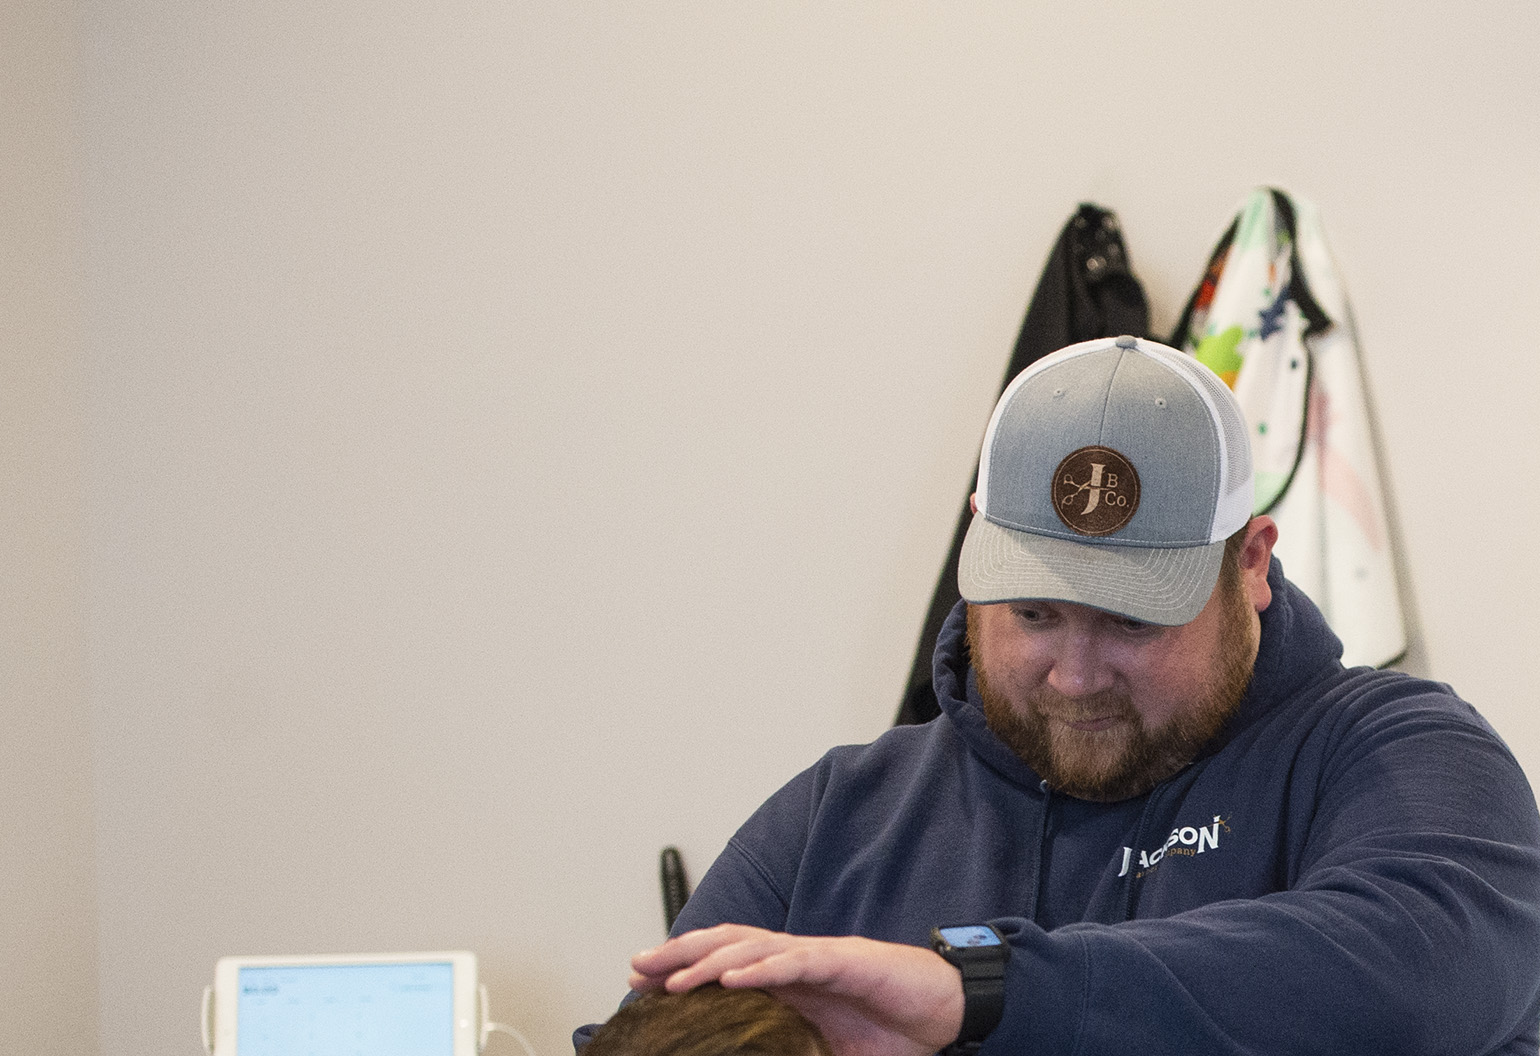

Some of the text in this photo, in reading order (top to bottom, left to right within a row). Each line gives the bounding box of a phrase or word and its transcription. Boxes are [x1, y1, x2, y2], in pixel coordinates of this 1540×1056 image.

[1107, 473, 1118, 488] B
[1105, 491, 1130, 507] Co.
[1118, 815, 1221, 877] JACSON
[1166, 848, 1197, 857] pany
